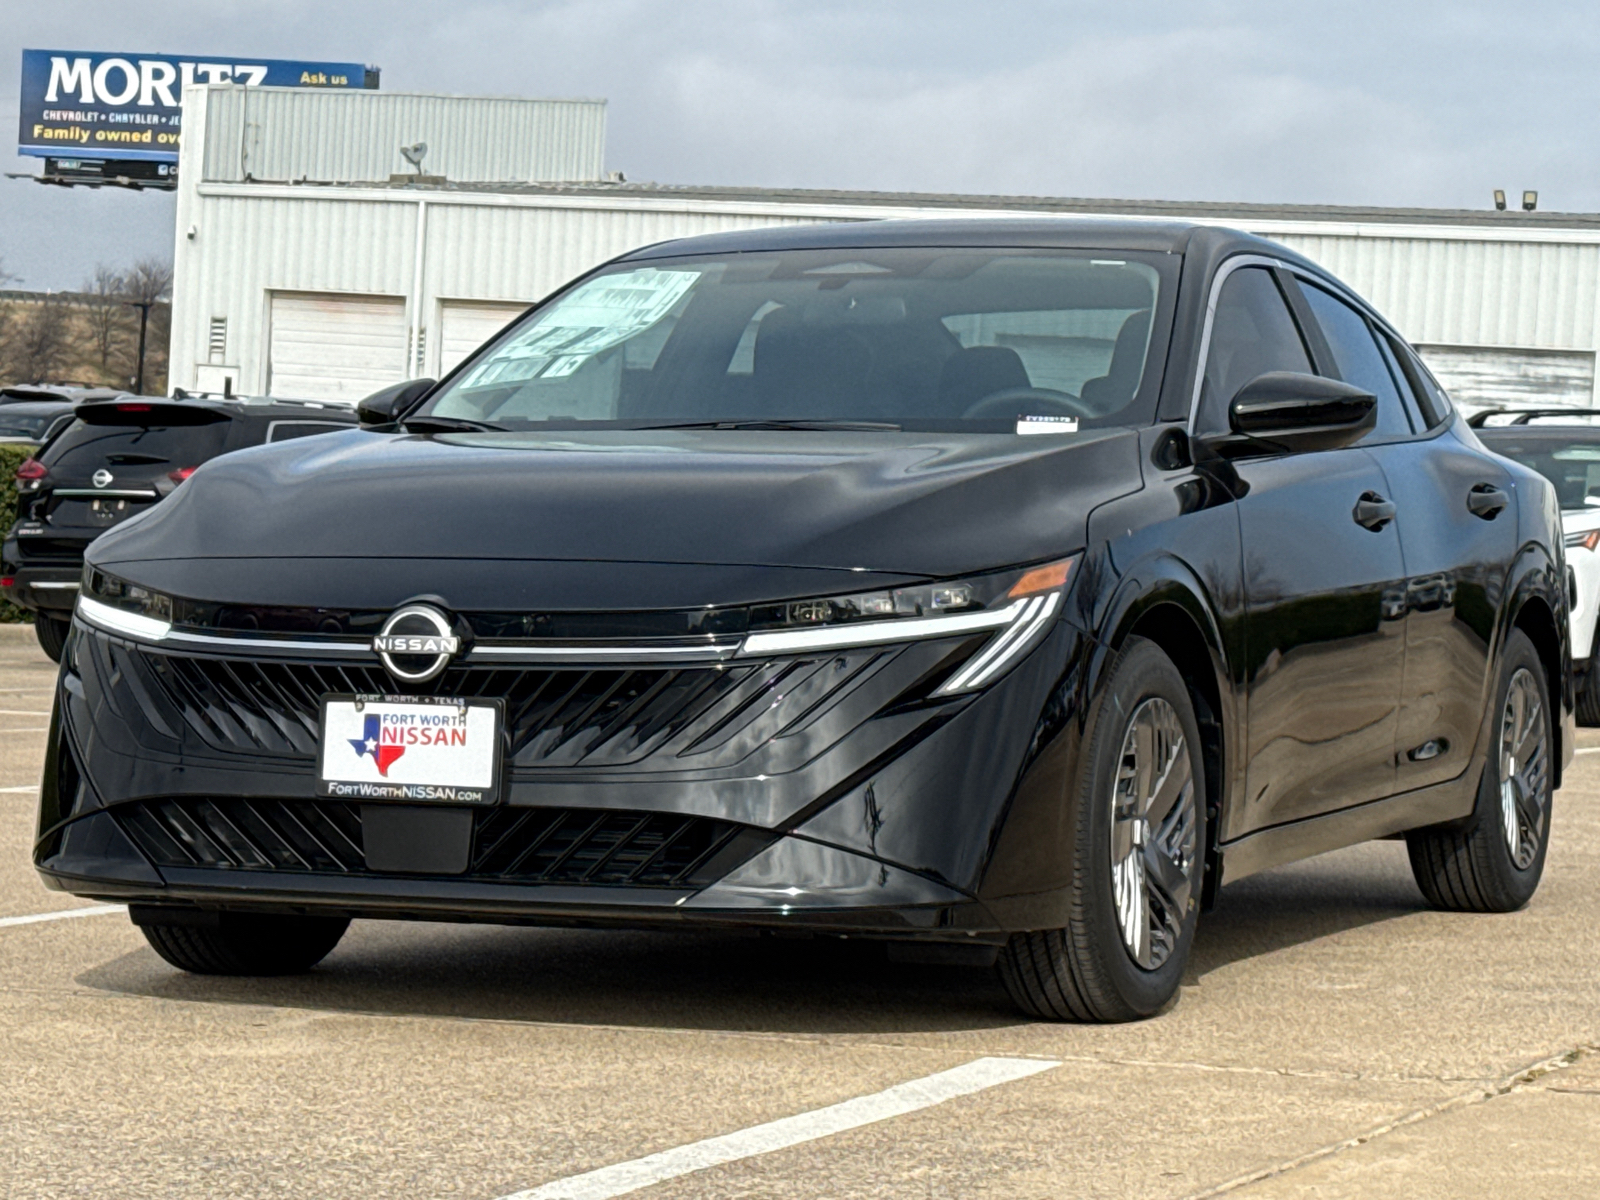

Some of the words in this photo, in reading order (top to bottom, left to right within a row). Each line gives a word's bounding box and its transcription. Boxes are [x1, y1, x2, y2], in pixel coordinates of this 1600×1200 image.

[300, 71, 327, 85] Ask
[331, 75, 348, 85] us
[43, 110, 99, 122] CHEVROLET
[108, 112, 159, 125] CHRYSLER
[33, 124, 91, 143] Family
[95, 129, 152, 143] owned
[374, 638, 456, 652] NISSAN
[355, 694, 380, 702] FORT
[385, 695, 419, 704] WORTH
[433, 696, 465, 706] TEXAS
[383, 714, 417, 725] FORT
[420, 715, 467, 727] WORTH
[382, 726, 467, 746] NISSAN
